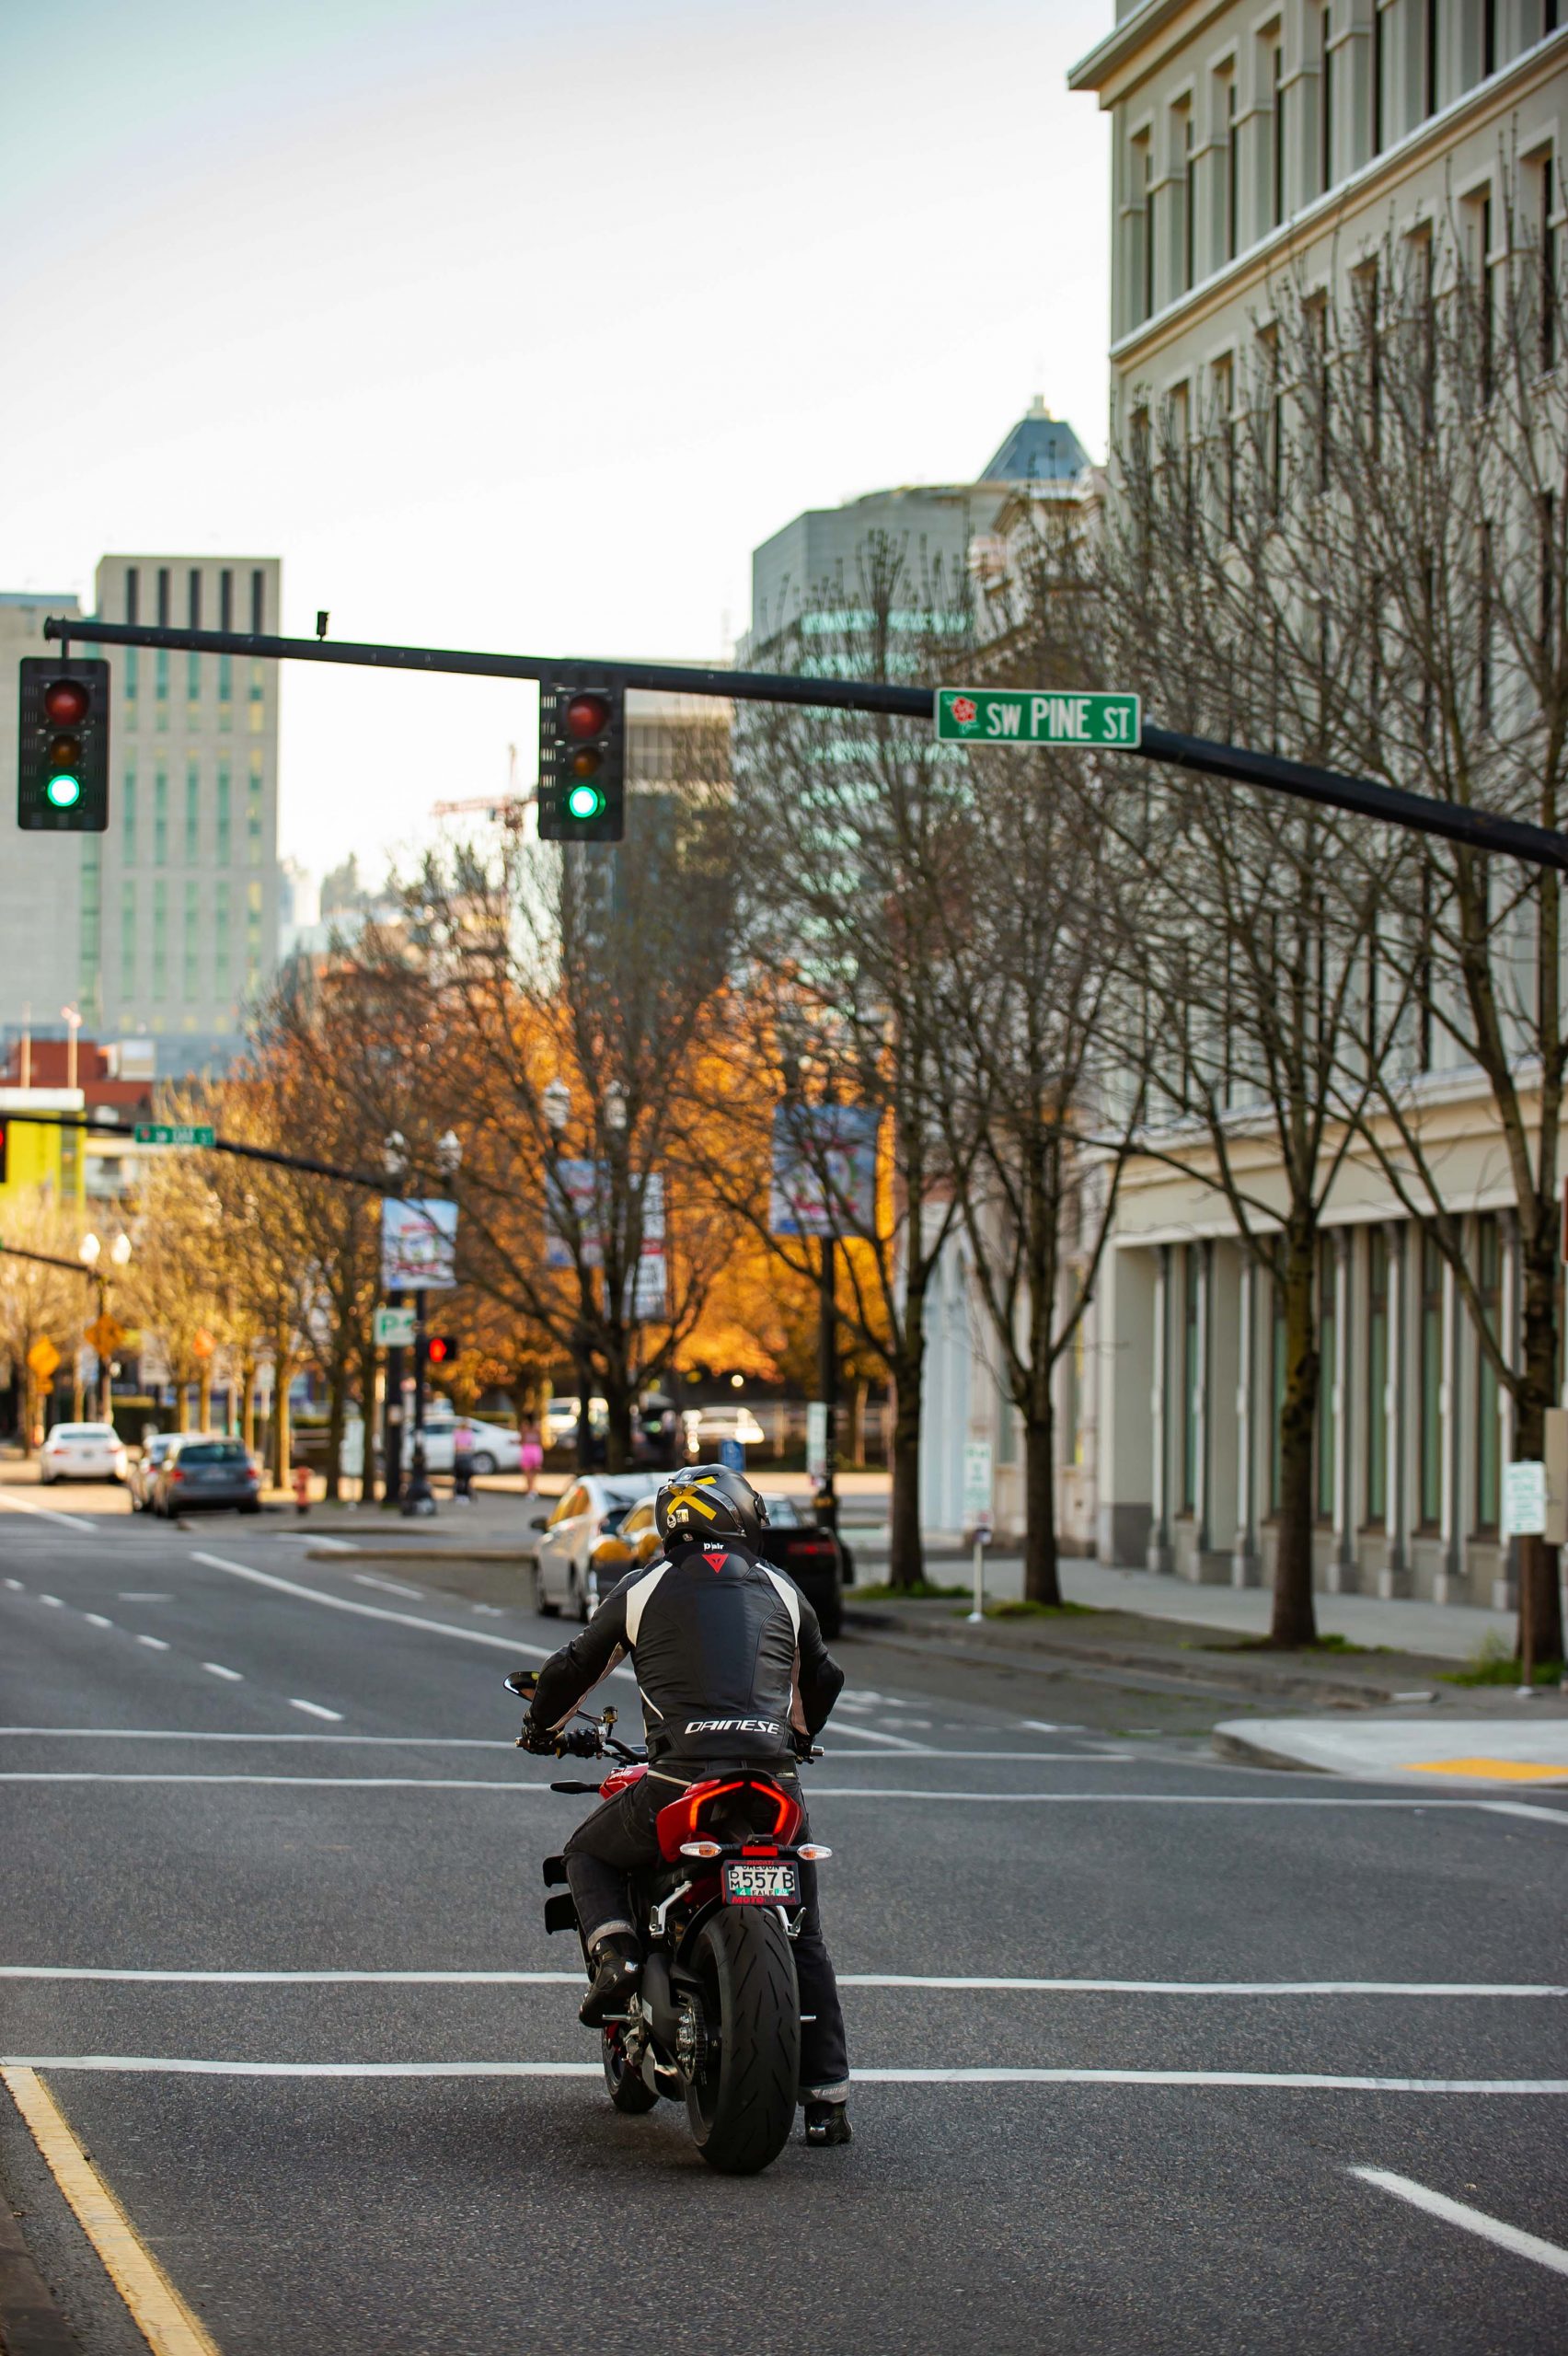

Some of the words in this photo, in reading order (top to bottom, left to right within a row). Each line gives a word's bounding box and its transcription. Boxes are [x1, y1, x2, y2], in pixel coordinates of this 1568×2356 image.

[986, 702, 1022, 736] SW
[1031, 697, 1092, 740] PINE
[1103, 707, 1131, 740] ST
[685, 1719, 779, 1735] DAINESE
